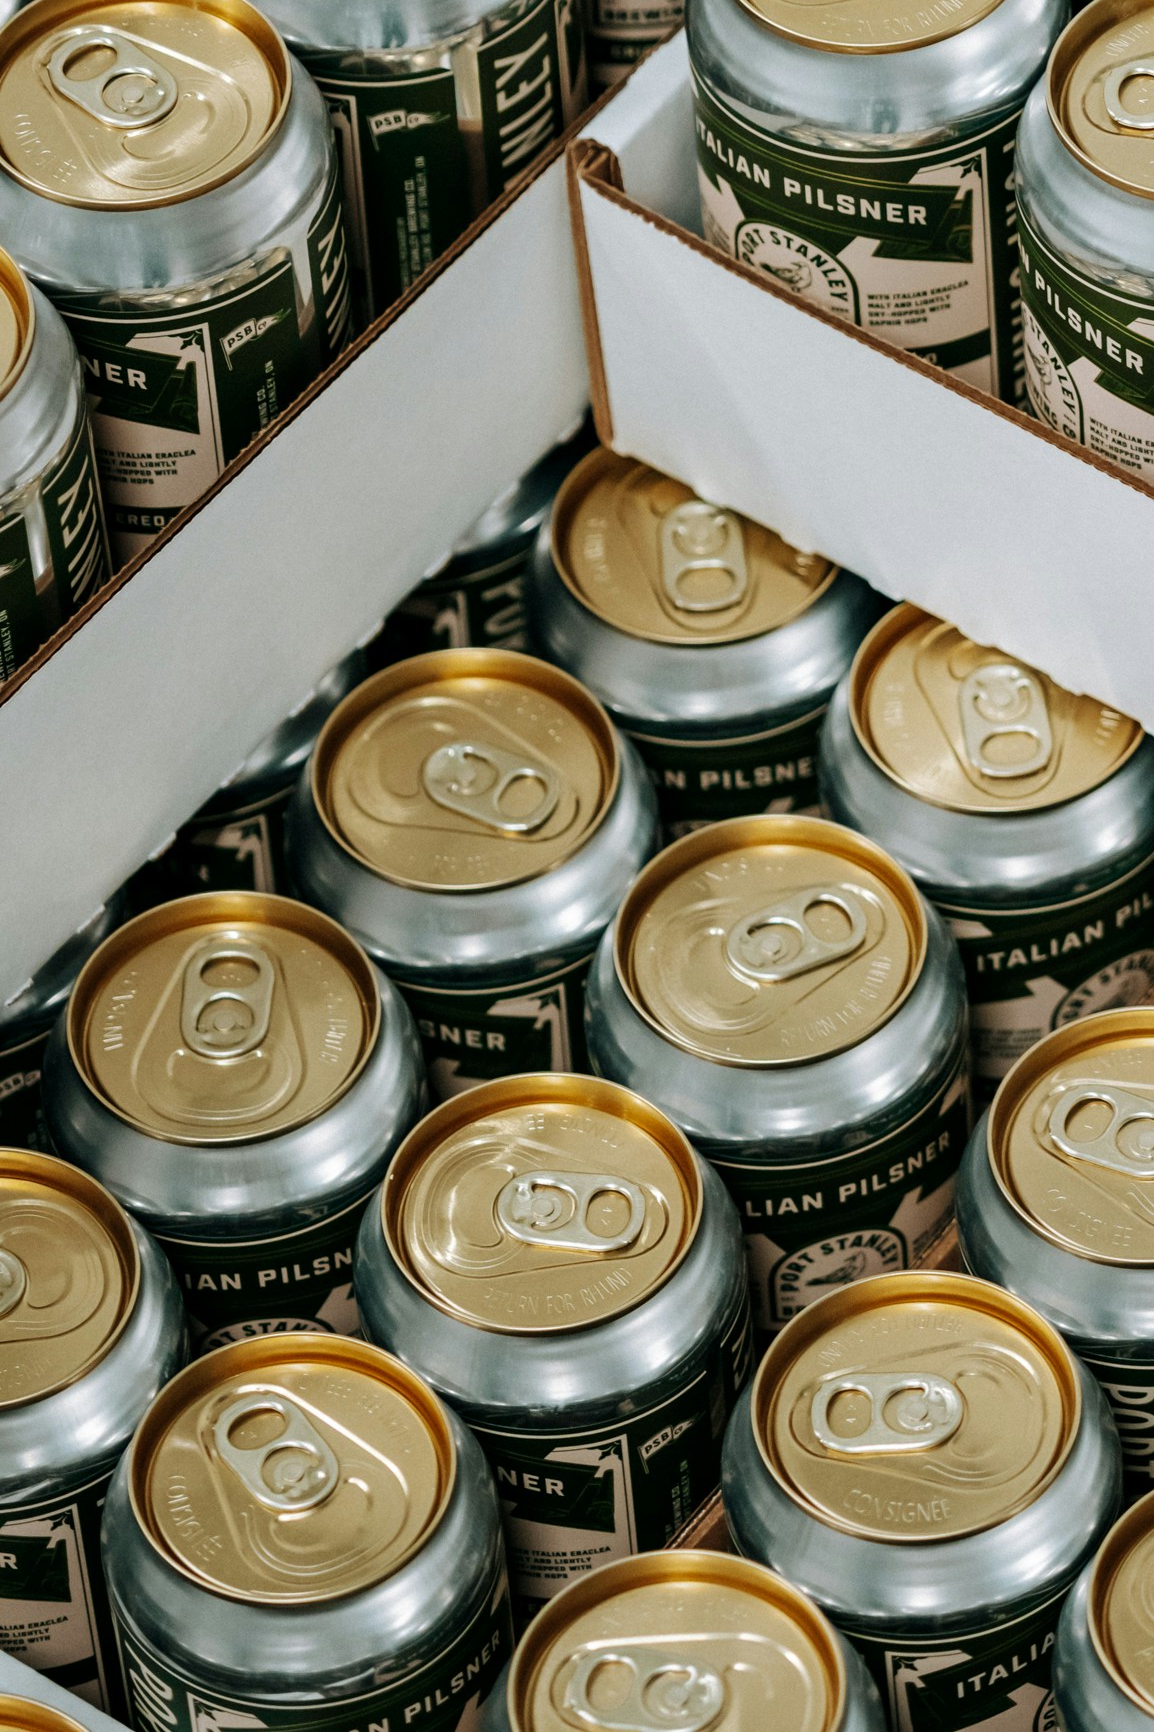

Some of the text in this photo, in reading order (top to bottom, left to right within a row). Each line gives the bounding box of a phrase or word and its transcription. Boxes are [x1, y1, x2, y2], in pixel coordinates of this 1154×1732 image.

[783, 176, 928, 226] PILSNER
[768, 229, 850, 303] STANLEY
[227, 324, 254, 350] PSB
[1034, 272, 1145, 376] PILSNER
[1089, 416, 1110, 433] WITH
[1110, 428, 1143, 445] ITALIAN
[1090, 425, 1110, 441] MALT
[1111, 435, 1128, 448] AND
[155, 448, 197, 459] ERACLEA
[1090, 433, 1141, 461] DRY-HOPPED
[153, 468, 178, 477] WITH
[701, 759, 813, 790] PILSNE
[976, 920, 1104, 974] ITALIAN
[745, 1130, 951, 1219] LIAN PILSNER
[257, 1247, 353, 1288] PILSN
[781, 1233, 899, 1293] PORT STANLEY
[644, 1430, 670, 1456] PSB
[12, 1628, 50, 1639] LIGHTLY
[21, 1615, 69, 1631] ERACLEA
[27, 1635, 51, 1645] WITH
[403, 1628, 501, 1725] PILSNER
[956, 1631, 1056, 1699] ITALIA
